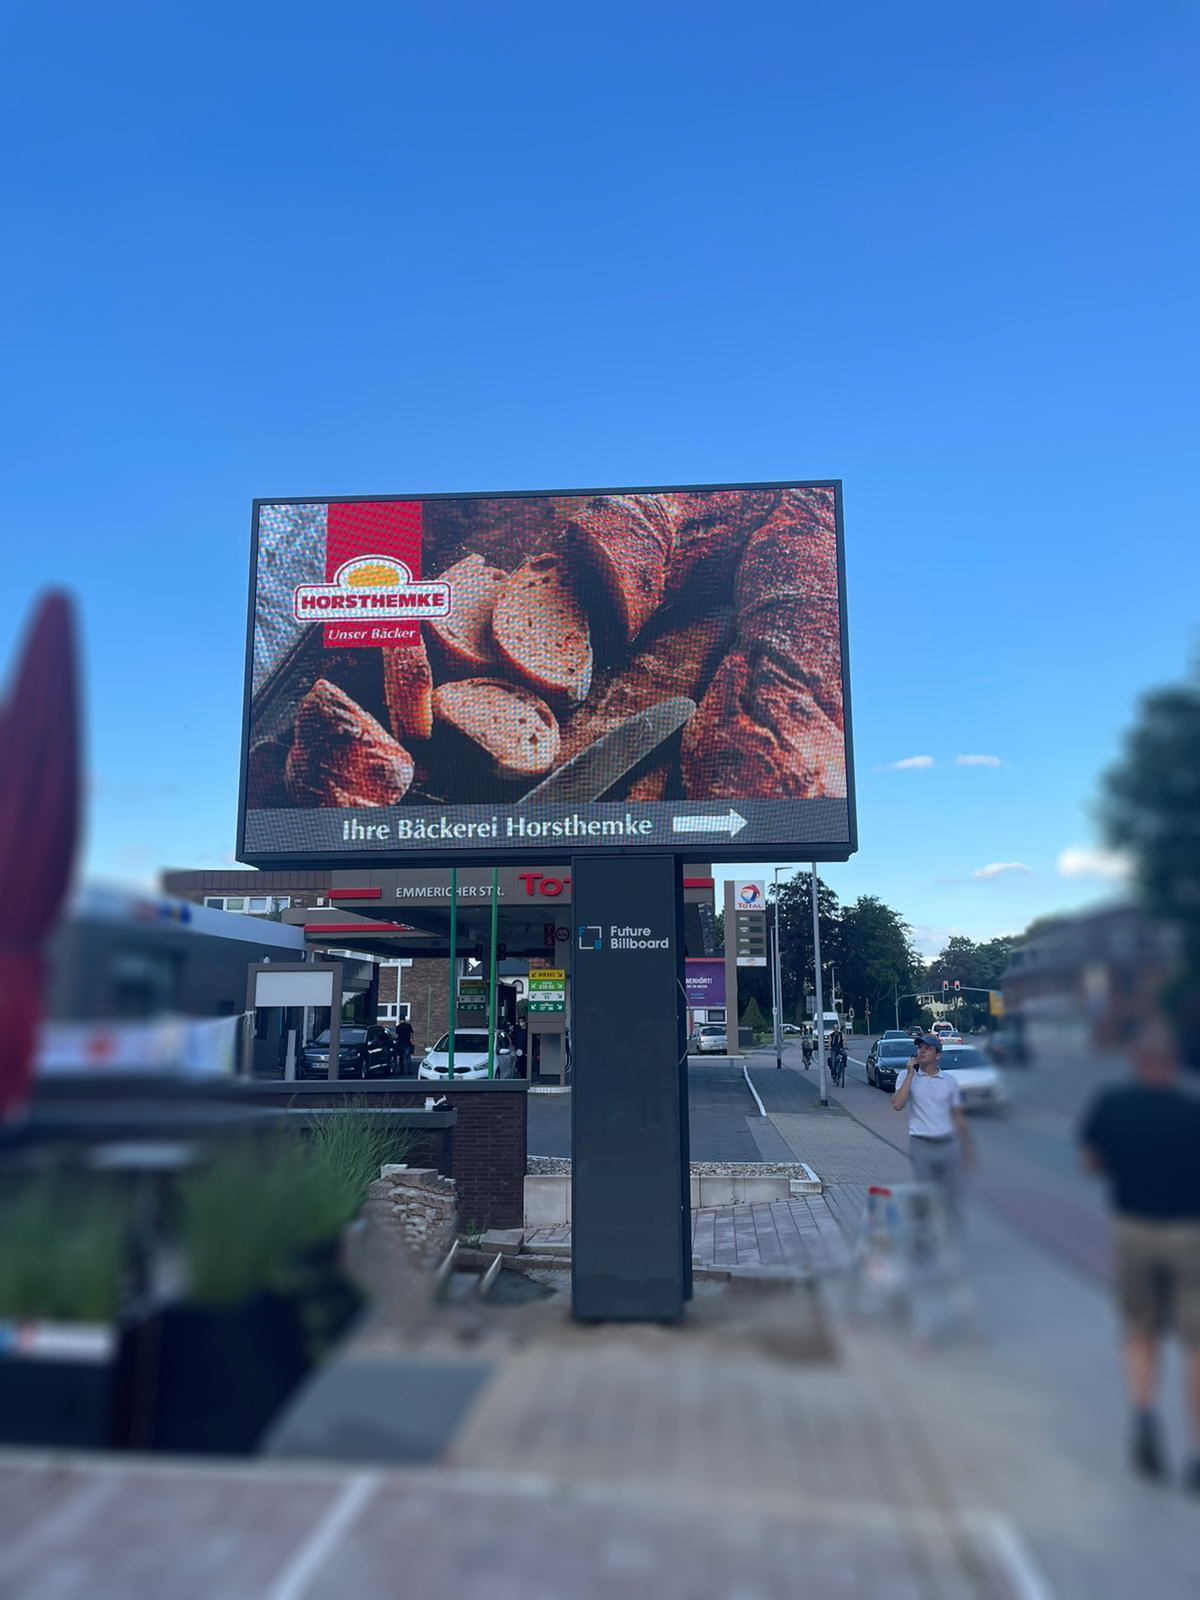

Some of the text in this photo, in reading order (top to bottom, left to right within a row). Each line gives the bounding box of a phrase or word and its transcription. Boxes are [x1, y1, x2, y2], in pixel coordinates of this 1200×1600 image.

[301, 592, 445, 610] HORSTHEMKE
[328, 627, 416, 640] Unser Bäcker
[342, 813, 653, 841] Ihre Bäckerei Horsthemke
[518, 873, 572, 897] TO
[610, 925, 652, 937] Future
[610, 937, 670, 949] Billboard
